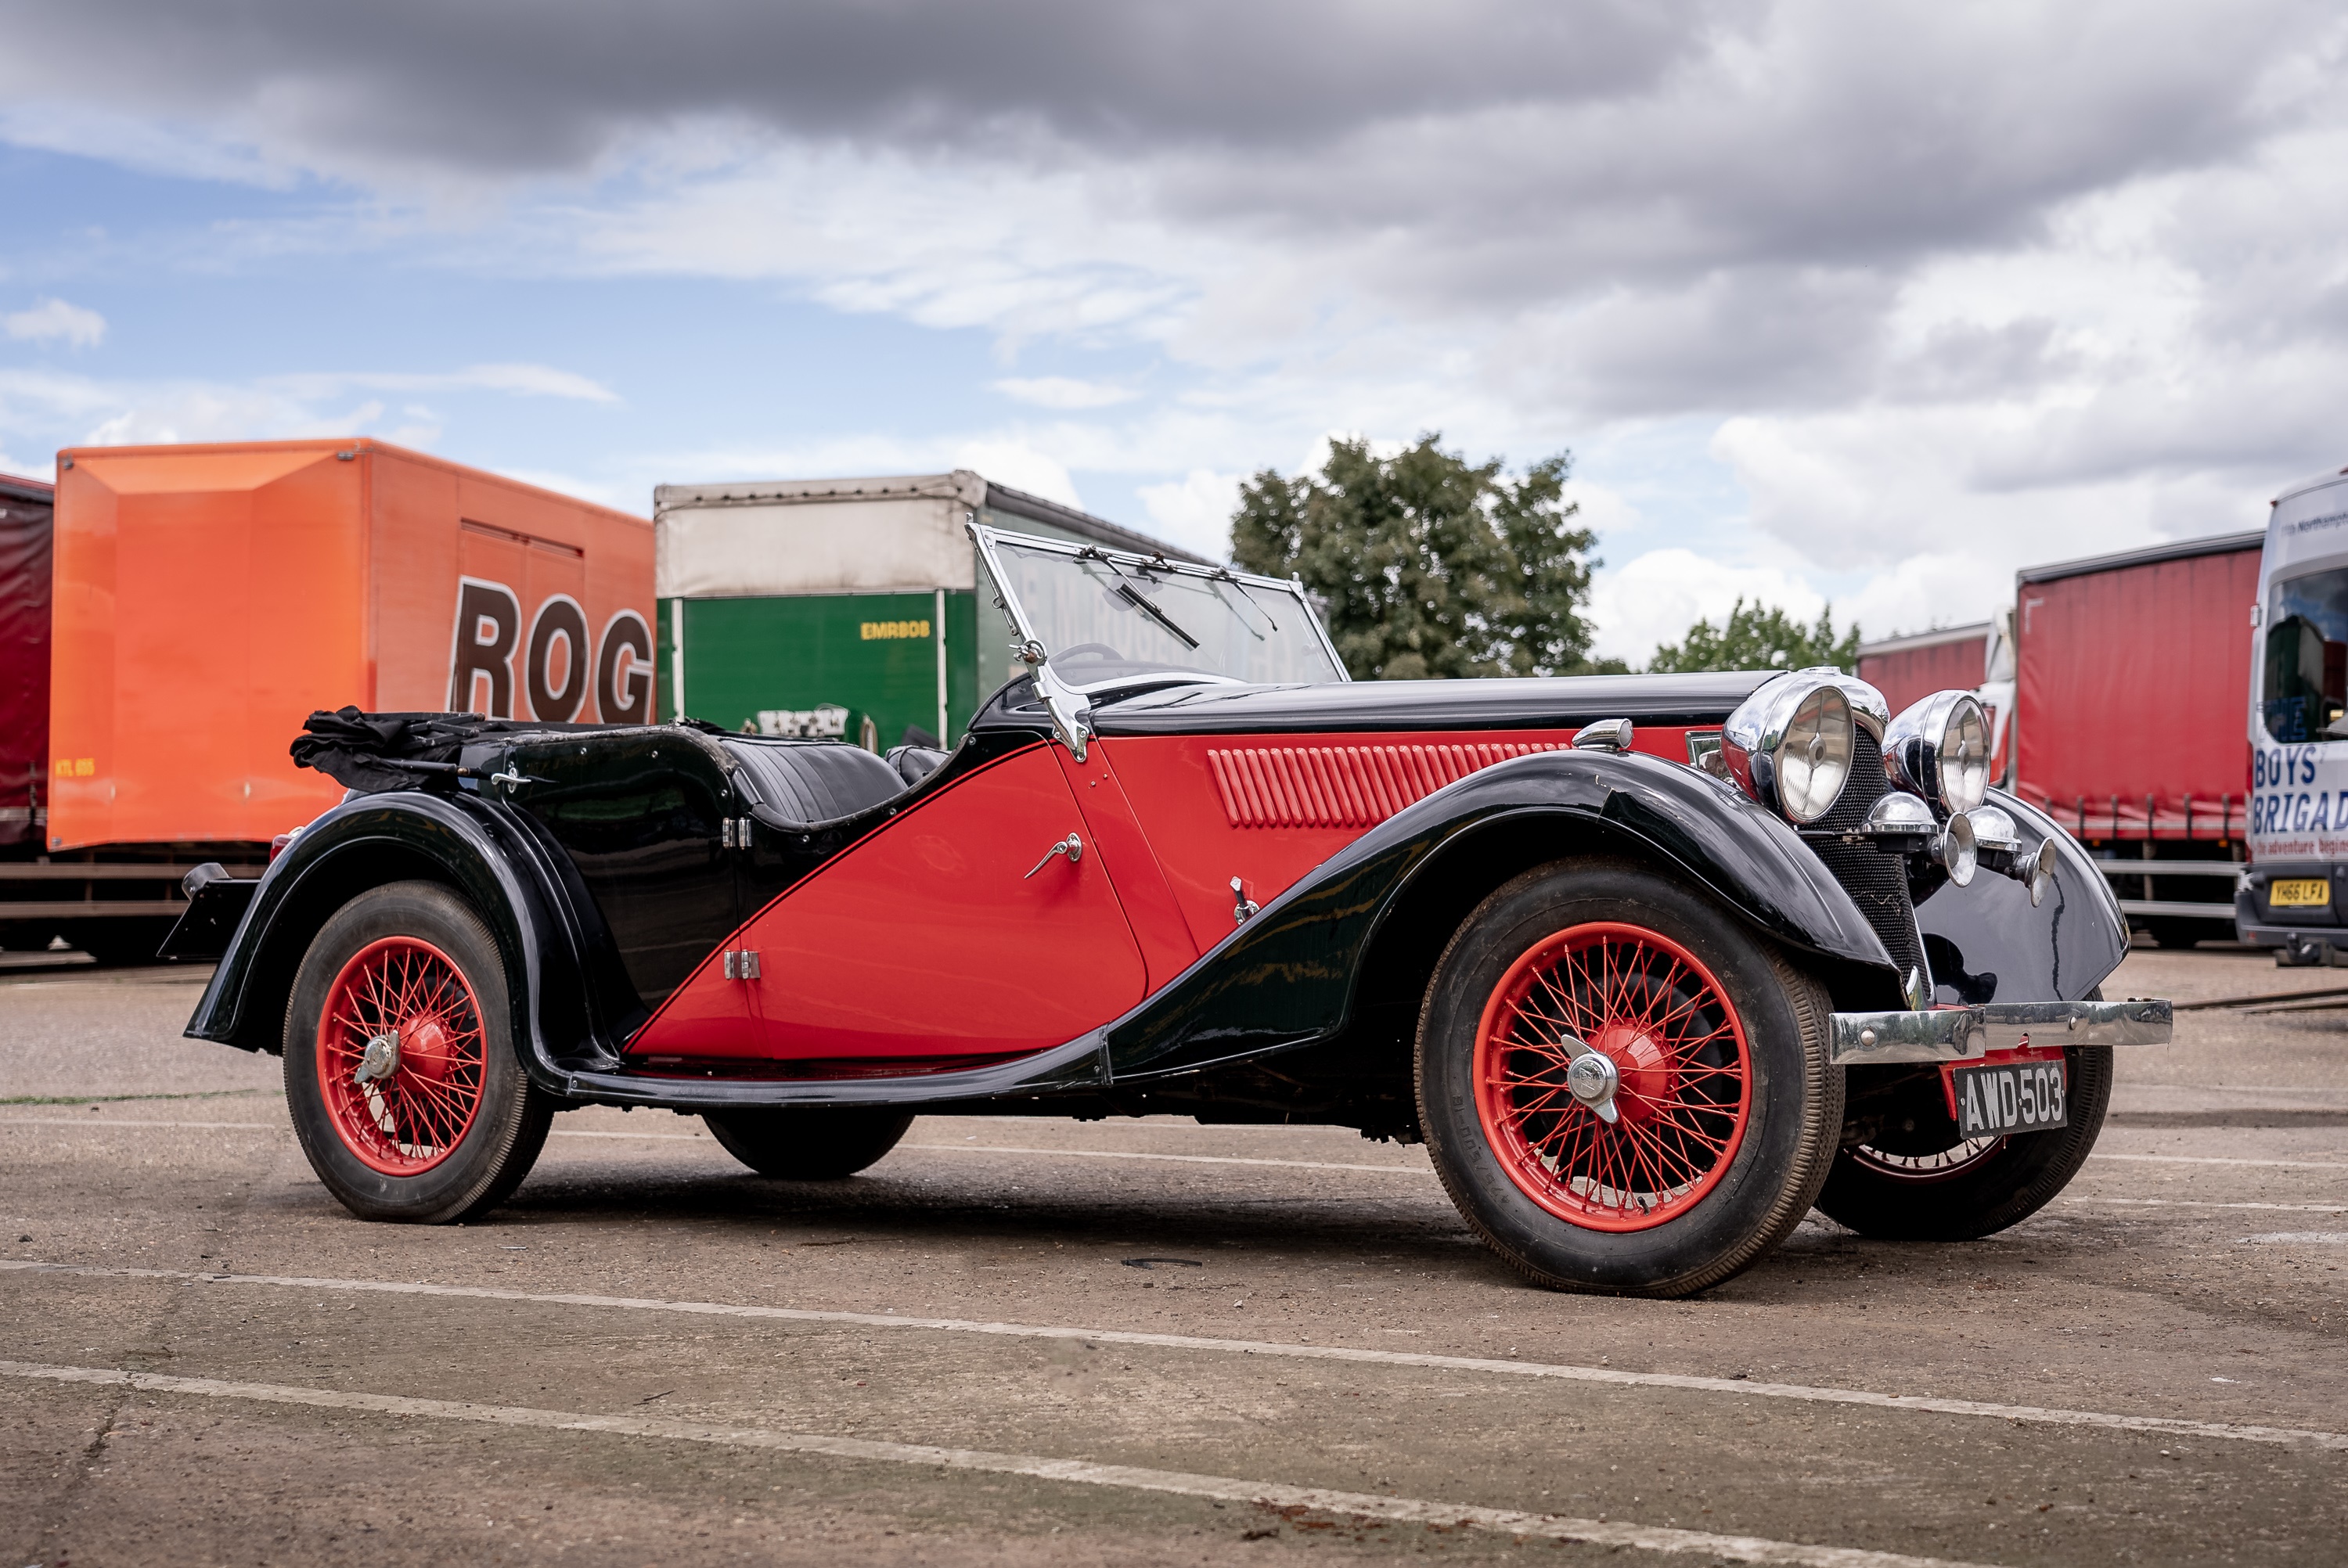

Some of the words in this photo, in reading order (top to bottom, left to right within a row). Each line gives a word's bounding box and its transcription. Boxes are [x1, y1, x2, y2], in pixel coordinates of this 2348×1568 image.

[445, 574, 654, 724] ROG
[2268, 837, 2314, 855] adventure
[2276, 883, 2300, 901] YH66
[2303, 883, 2324, 900] LFA
